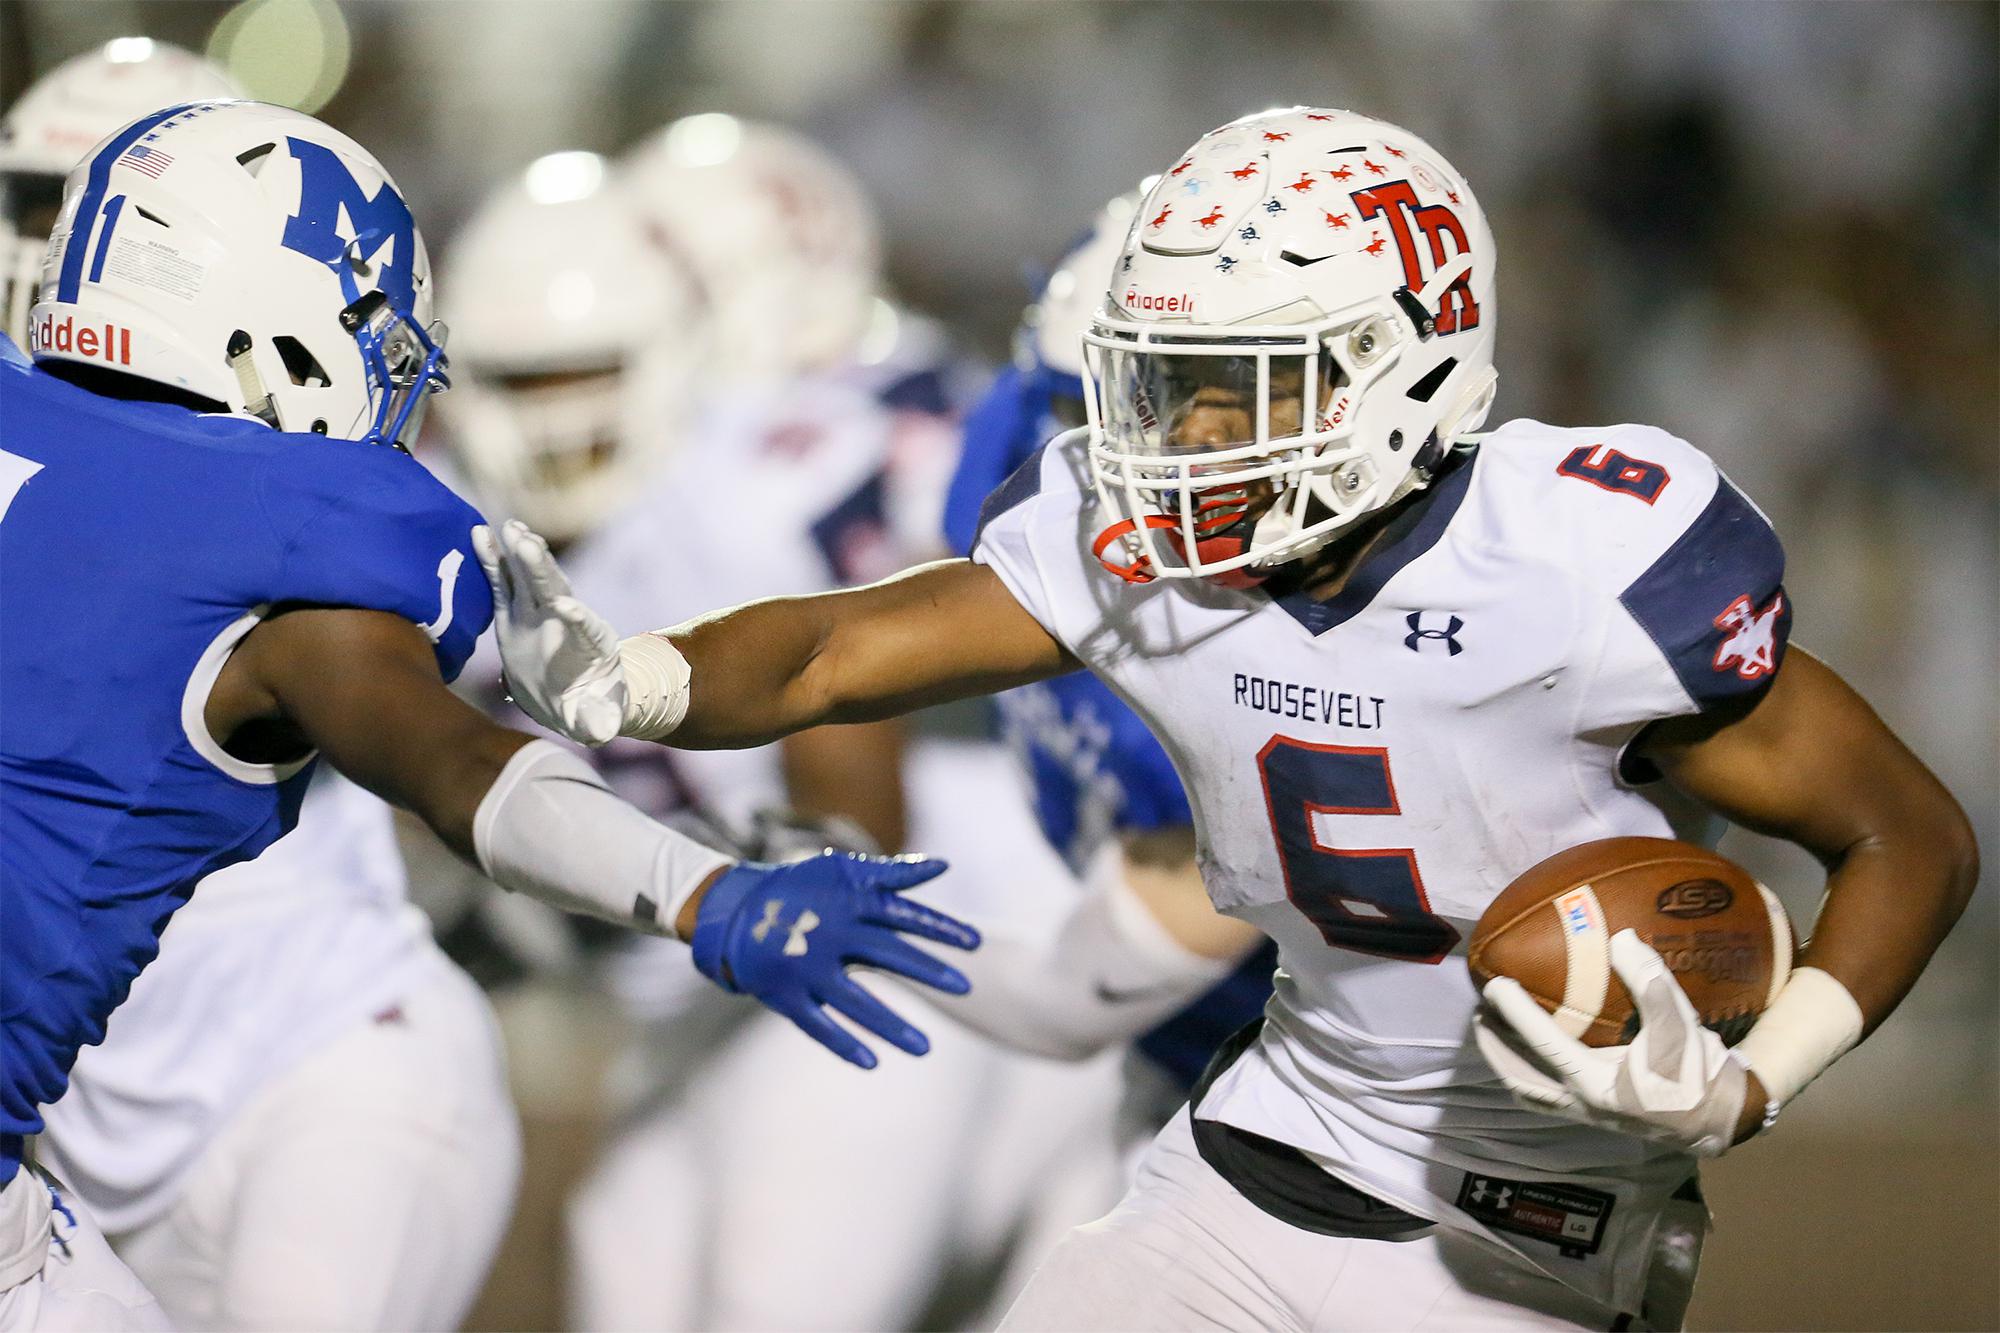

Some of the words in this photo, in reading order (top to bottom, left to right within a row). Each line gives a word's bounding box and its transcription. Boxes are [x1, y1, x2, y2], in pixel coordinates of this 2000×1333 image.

[89, 195, 126, 283] 1
[281, 135, 416, 315] M
[1349, 179, 1480, 337] TR
[1556, 443, 1671, 506] 6
[1234, 673, 1385, 729] ROOSEVELT
[1256, 734, 1462, 965] 6
[1513, 1208, 1562, 1228] AUTHENTIC
